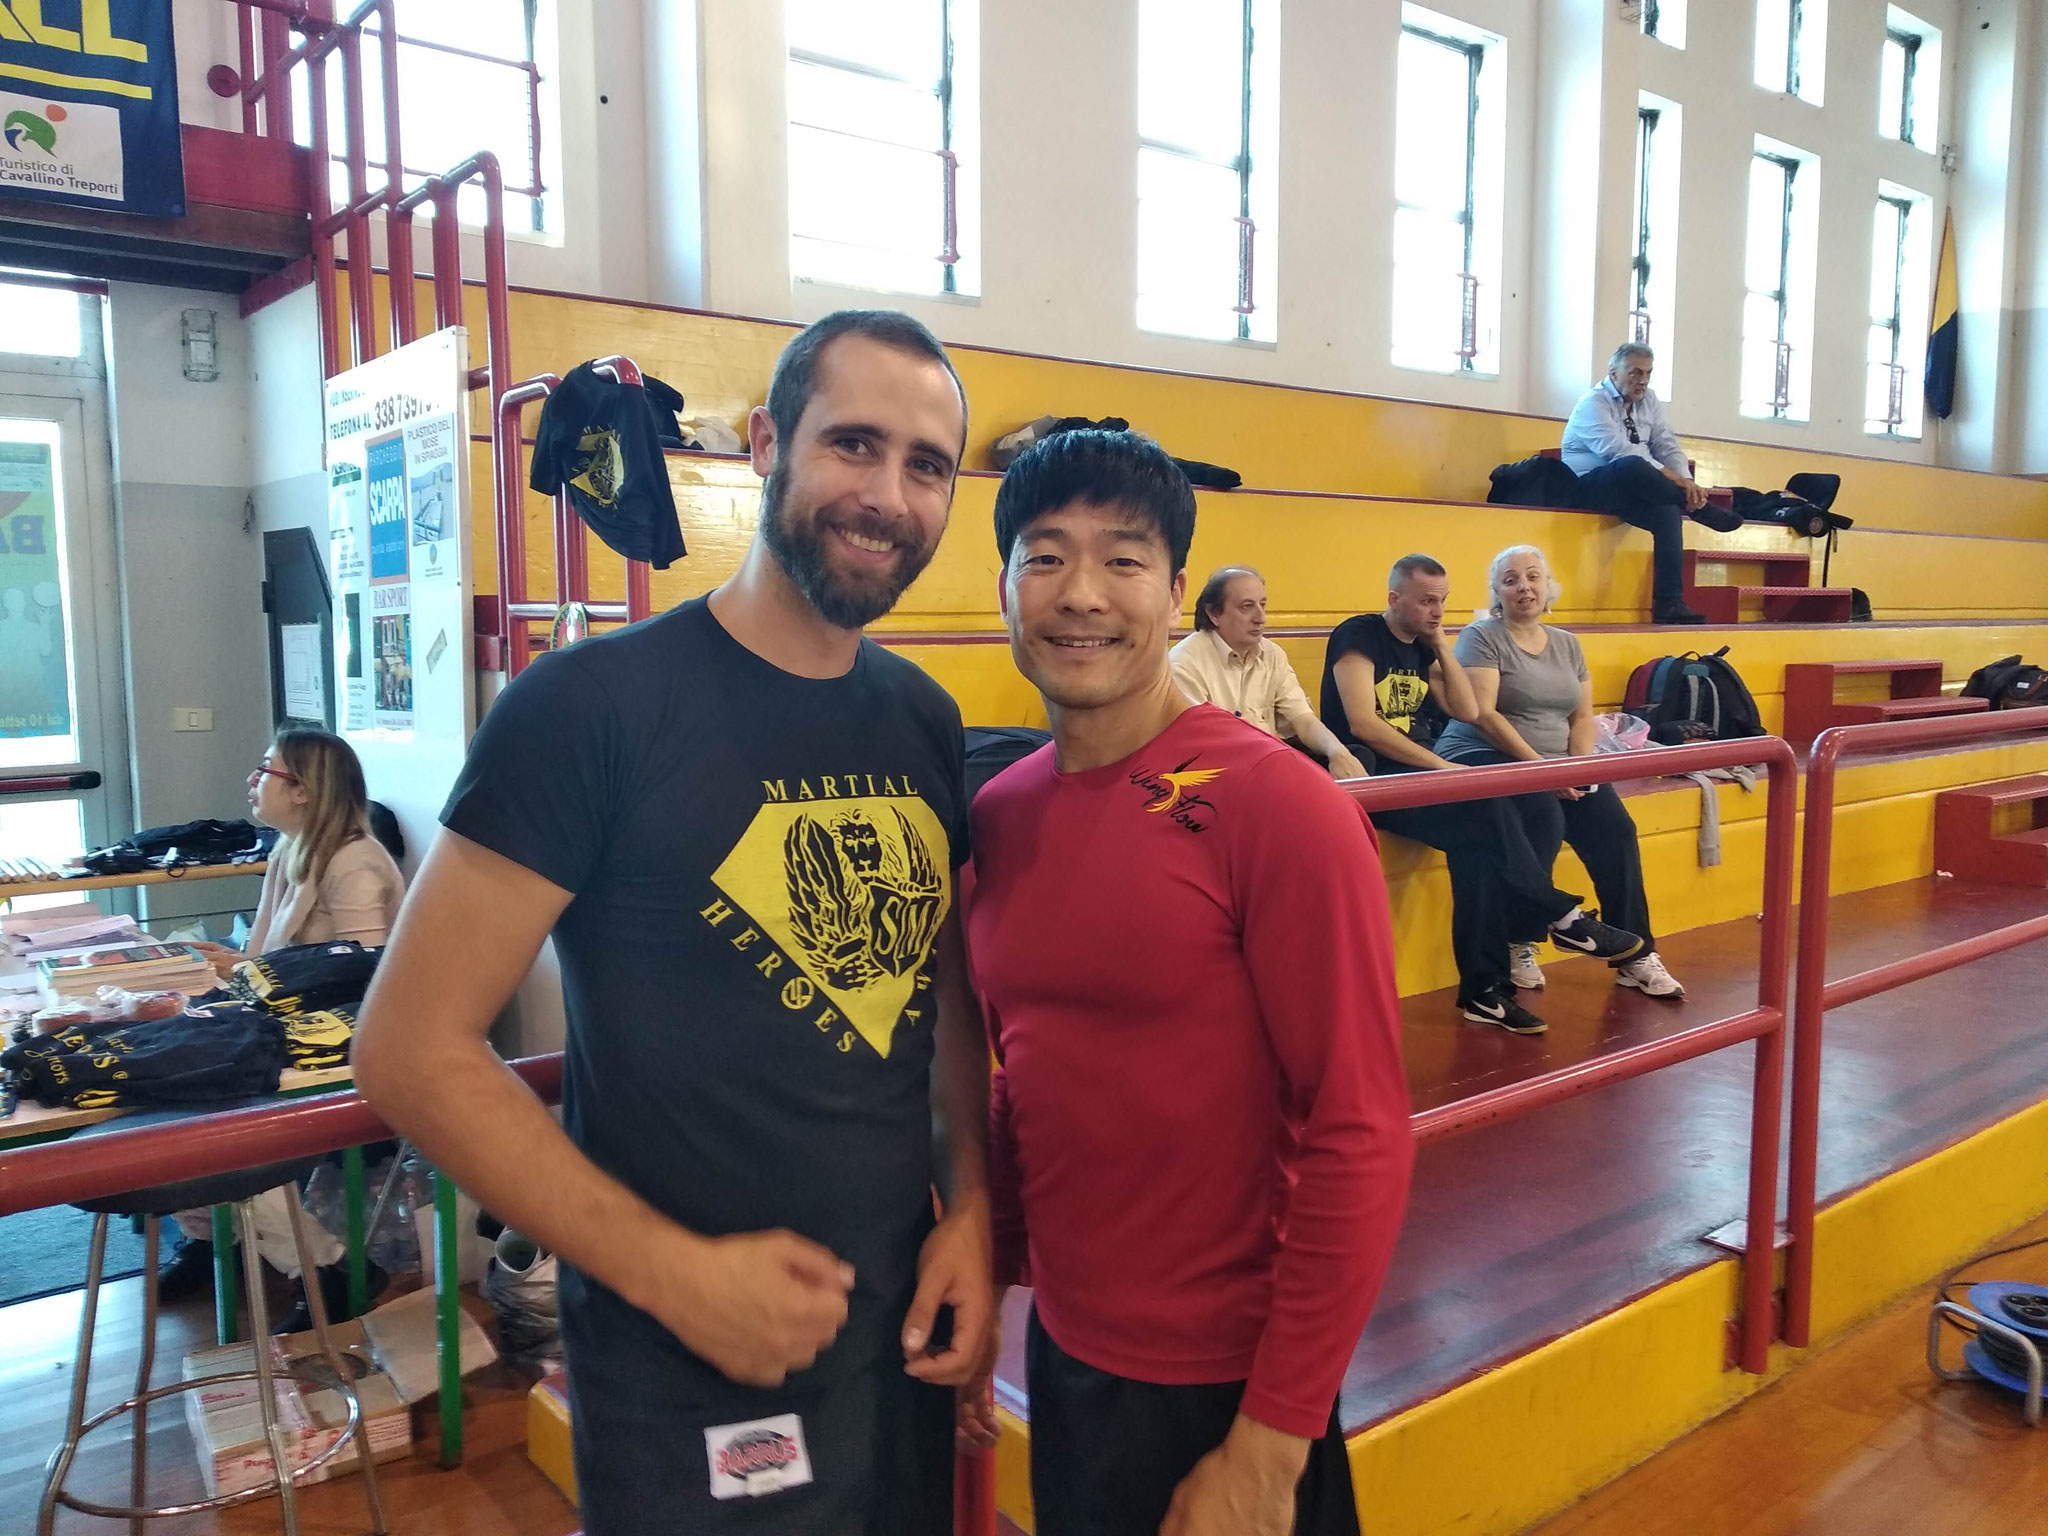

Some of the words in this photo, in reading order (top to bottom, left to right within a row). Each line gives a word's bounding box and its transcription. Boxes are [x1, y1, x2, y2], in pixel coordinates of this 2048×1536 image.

[0, 157, 57, 173] Turistico
[61, 164, 74, 175] di
[0, 170, 64, 186] Cavallino
[68, 177, 118, 194] Treporti
[330, 415, 361, 439] TELEFONA
[363, 412, 371, 429] AL
[408, 423, 437, 440] PLASTICO
[438, 419, 450, 431] DEL
[422, 435, 439, 449] MOSE
[370, 475, 405, 526] SCARPA
[373, 589, 387, 609] BAR
[387, 586, 408, 608] SPORT
[761, 774, 918, 801] MARTIAL
